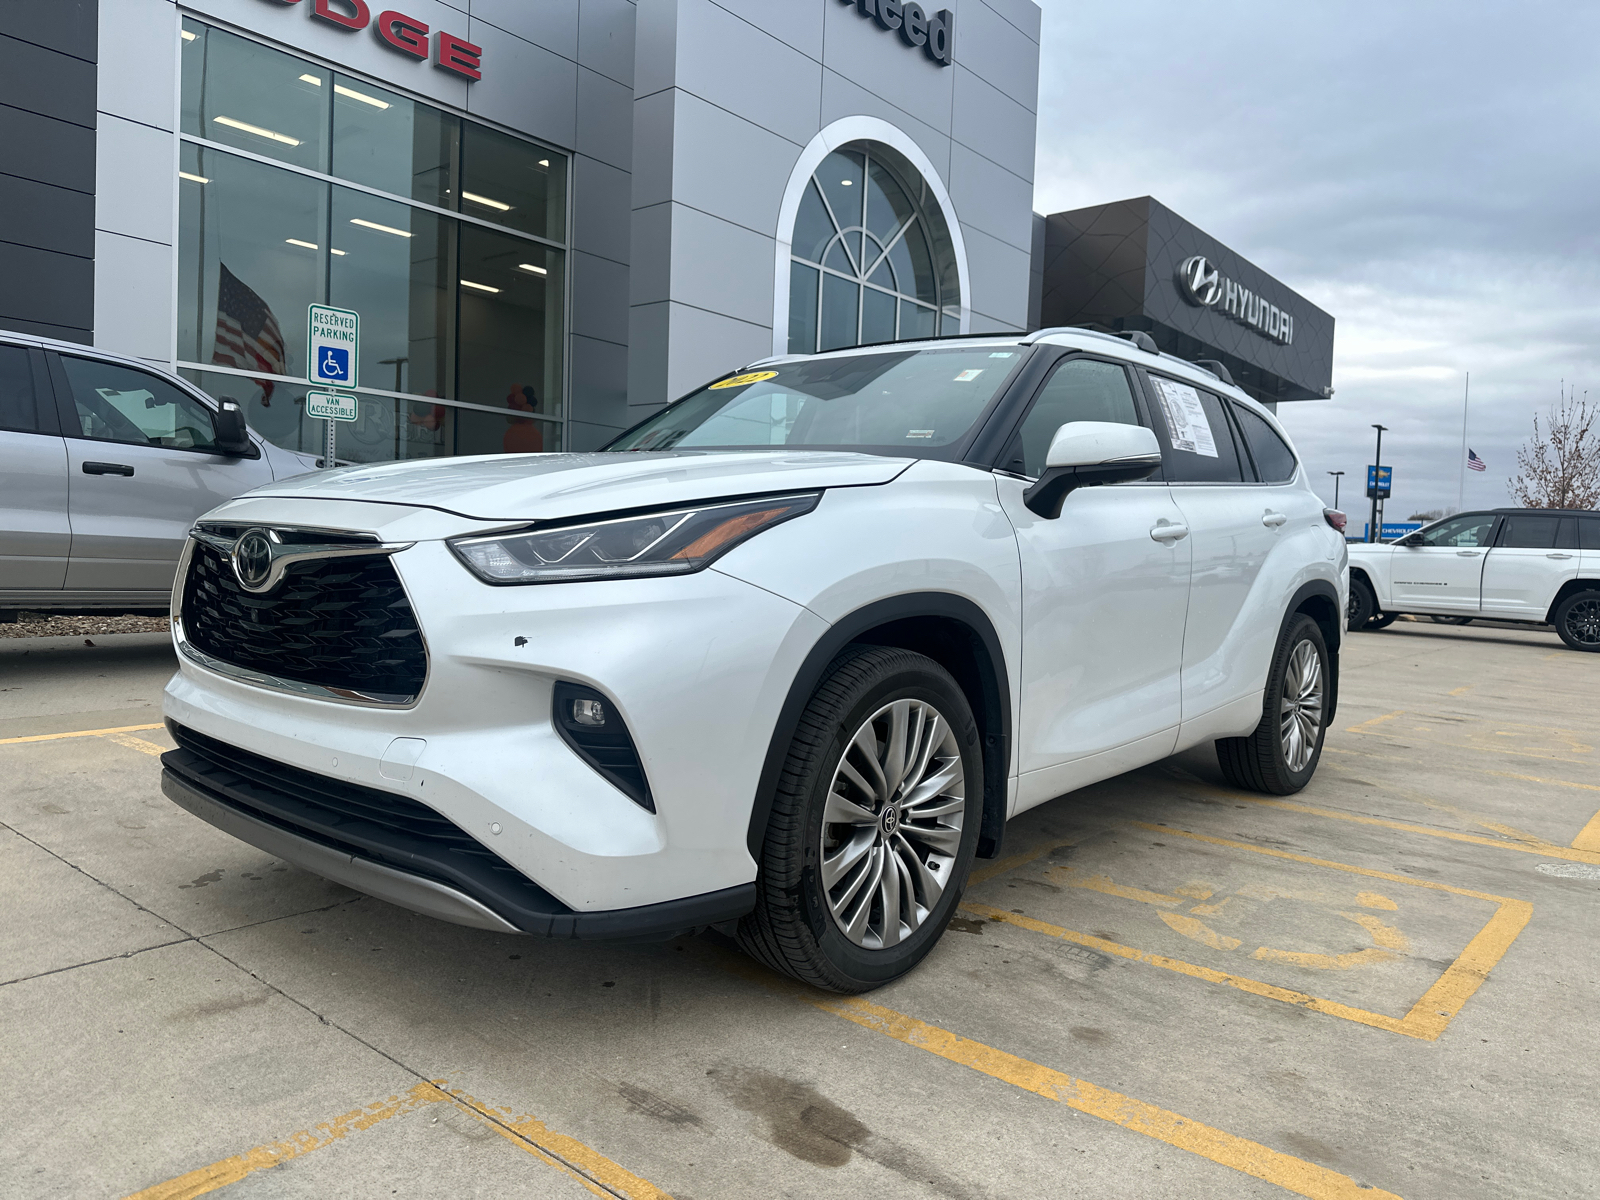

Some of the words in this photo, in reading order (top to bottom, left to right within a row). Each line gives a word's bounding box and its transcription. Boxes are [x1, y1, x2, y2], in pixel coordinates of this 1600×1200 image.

[286, 0, 482, 81] DGE
[838, 0, 953, 66] eed
[1224, 277, 1294, 345] HYUNDAI
[313, 312, 354, 329] RESERVED
[313, 325, 354, 343] PARKING
[310, 404, 354, 417] ACCESSIBLE
[325, 397, 340, 406] VAN
